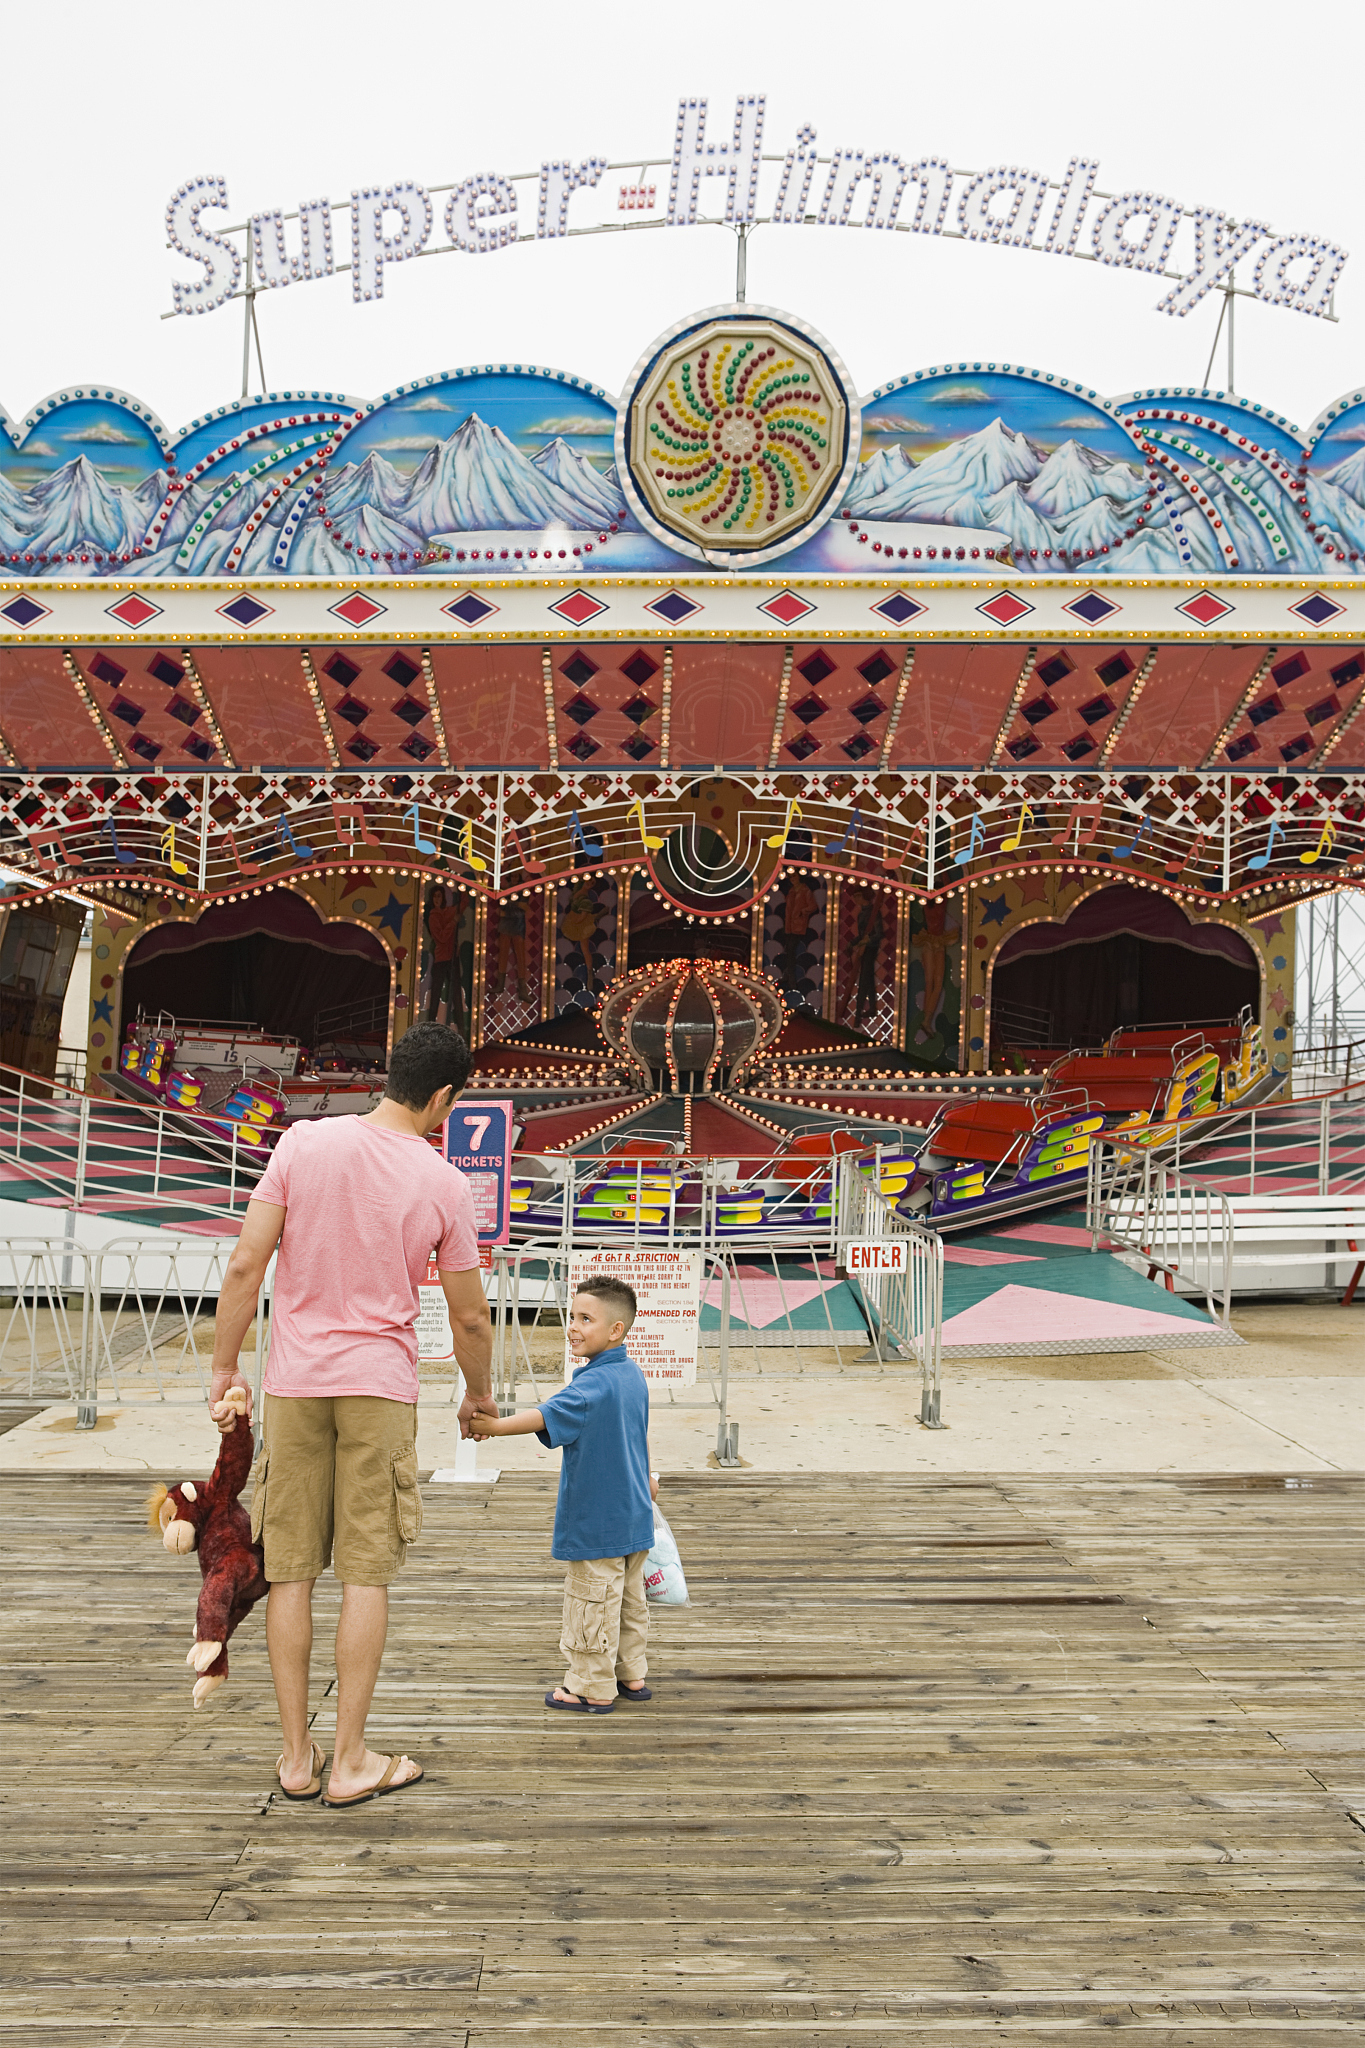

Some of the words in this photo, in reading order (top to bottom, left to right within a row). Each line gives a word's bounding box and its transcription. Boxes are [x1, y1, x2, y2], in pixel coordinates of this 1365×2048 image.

[223, 1050, 238, 1062] 15
[313, 1099, 330, 1111] 16
[463, 1115, 492, 1152] 7
[450, 1156, 503, 1167] TICKETS
[591, 1253, 622, 1262] HEGHT
[625, 1253, 680, 1262] RSTRICTION
[427, 1267, 439, 1280] La
[642, 1370, 654, 1378] INK
